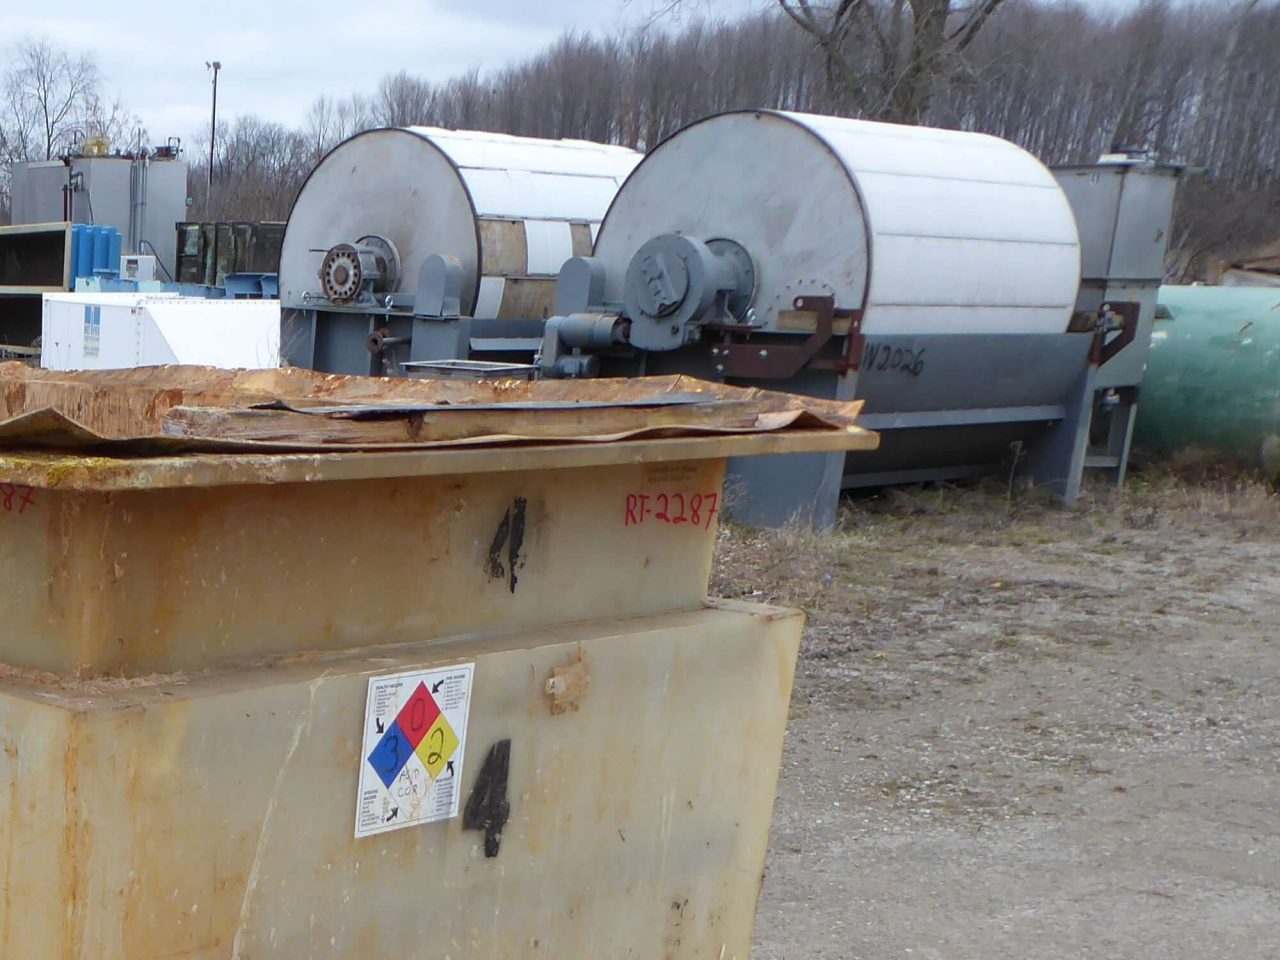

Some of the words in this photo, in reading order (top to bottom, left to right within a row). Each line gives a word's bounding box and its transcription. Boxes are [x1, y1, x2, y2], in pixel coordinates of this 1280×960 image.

[624, 492, 718, 531] RT-2287
[384, 735, 399, 774] 3
[427, 727, 443, 766] 2
[462, 738, 512, 858] 4
